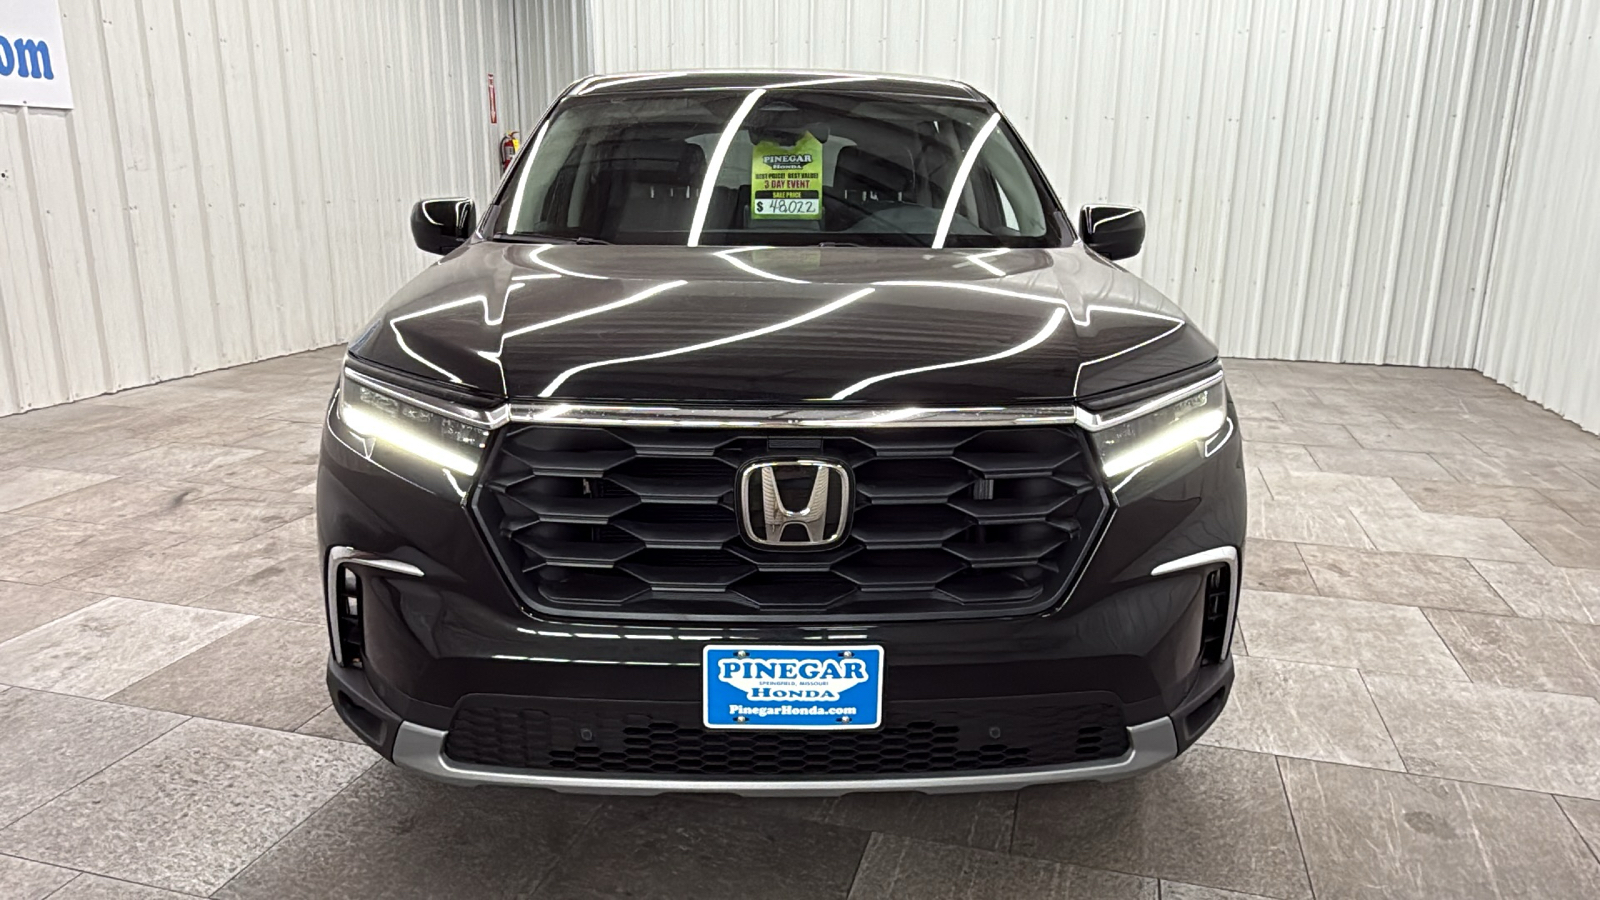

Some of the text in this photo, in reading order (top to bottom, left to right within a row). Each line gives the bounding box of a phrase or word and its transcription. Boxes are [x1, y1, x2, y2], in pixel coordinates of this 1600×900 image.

[763, 155, 812, 163] PINEGAR
[764, 179, 810, 189] 3 DAY EVENT
[756, 201, 764, 212] $
[722, 662, 865, 680] PINEGAR
[751, 687, 836, 698] HONDA
[729, 704, 857, 717] PinegarHonda.com
